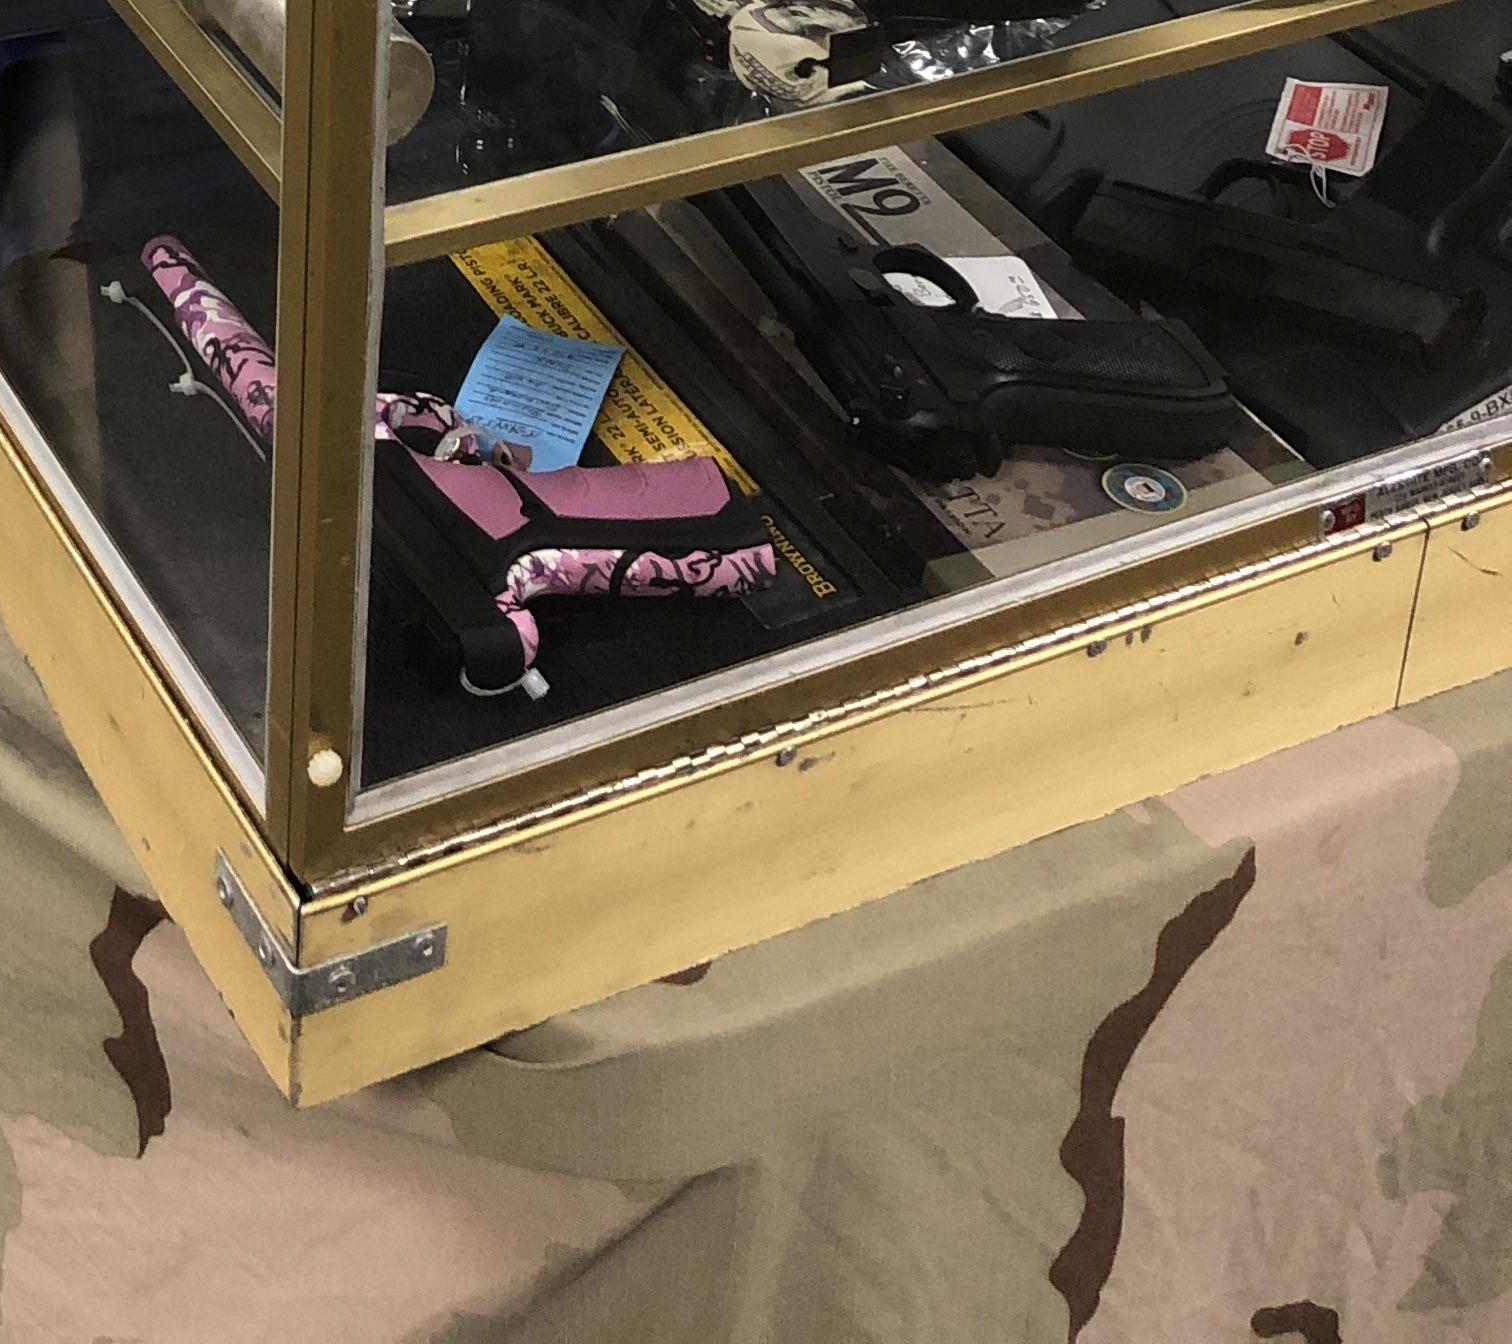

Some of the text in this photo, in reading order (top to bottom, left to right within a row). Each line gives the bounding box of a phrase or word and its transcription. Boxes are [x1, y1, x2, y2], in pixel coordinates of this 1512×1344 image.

[1306, 131, 1331, 160] STOP
[817, 157, 921, 216] M9
[545, 294, 591, 339] CALIBRE
[760, 514, 837, 599] BROWNING
